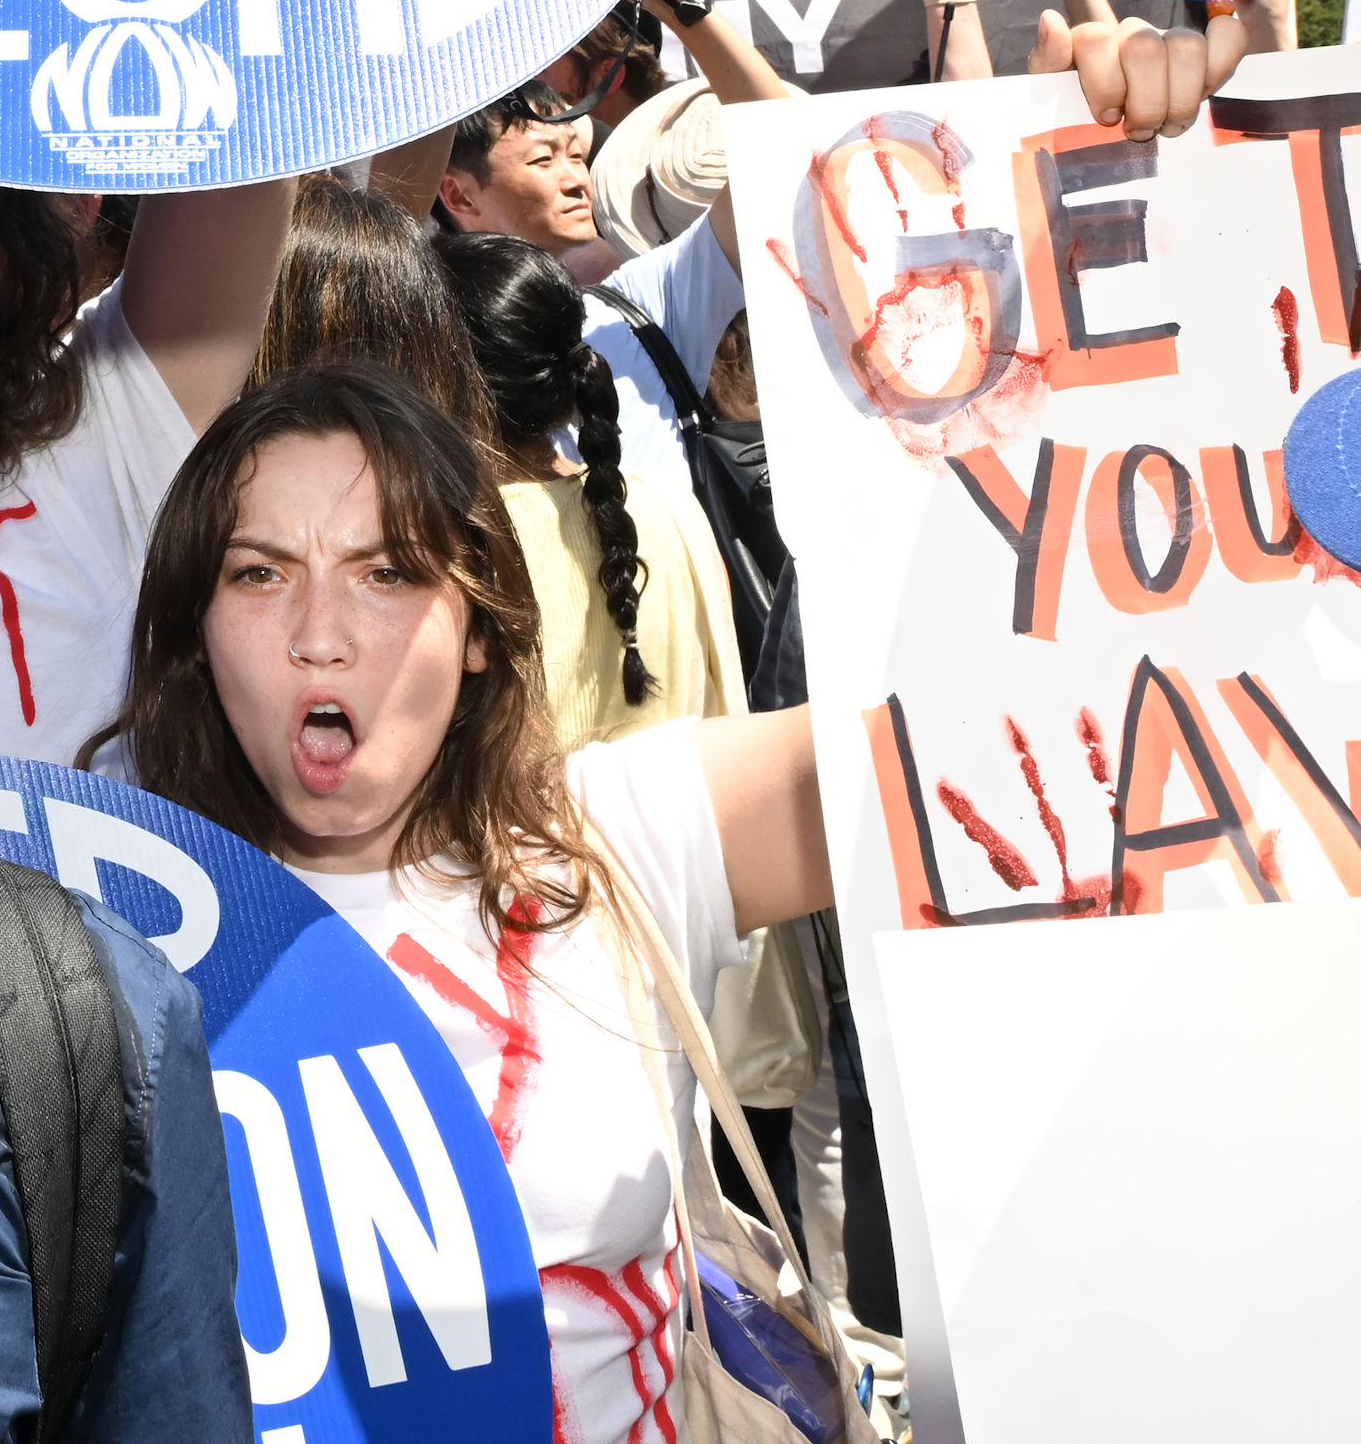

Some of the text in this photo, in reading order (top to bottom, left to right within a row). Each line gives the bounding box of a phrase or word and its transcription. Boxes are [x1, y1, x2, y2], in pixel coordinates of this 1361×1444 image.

[29, 20, 239, 131] NOW
[49, 135, 222, 149] NATIONAL
[791, 92, 1361, 423] GET
